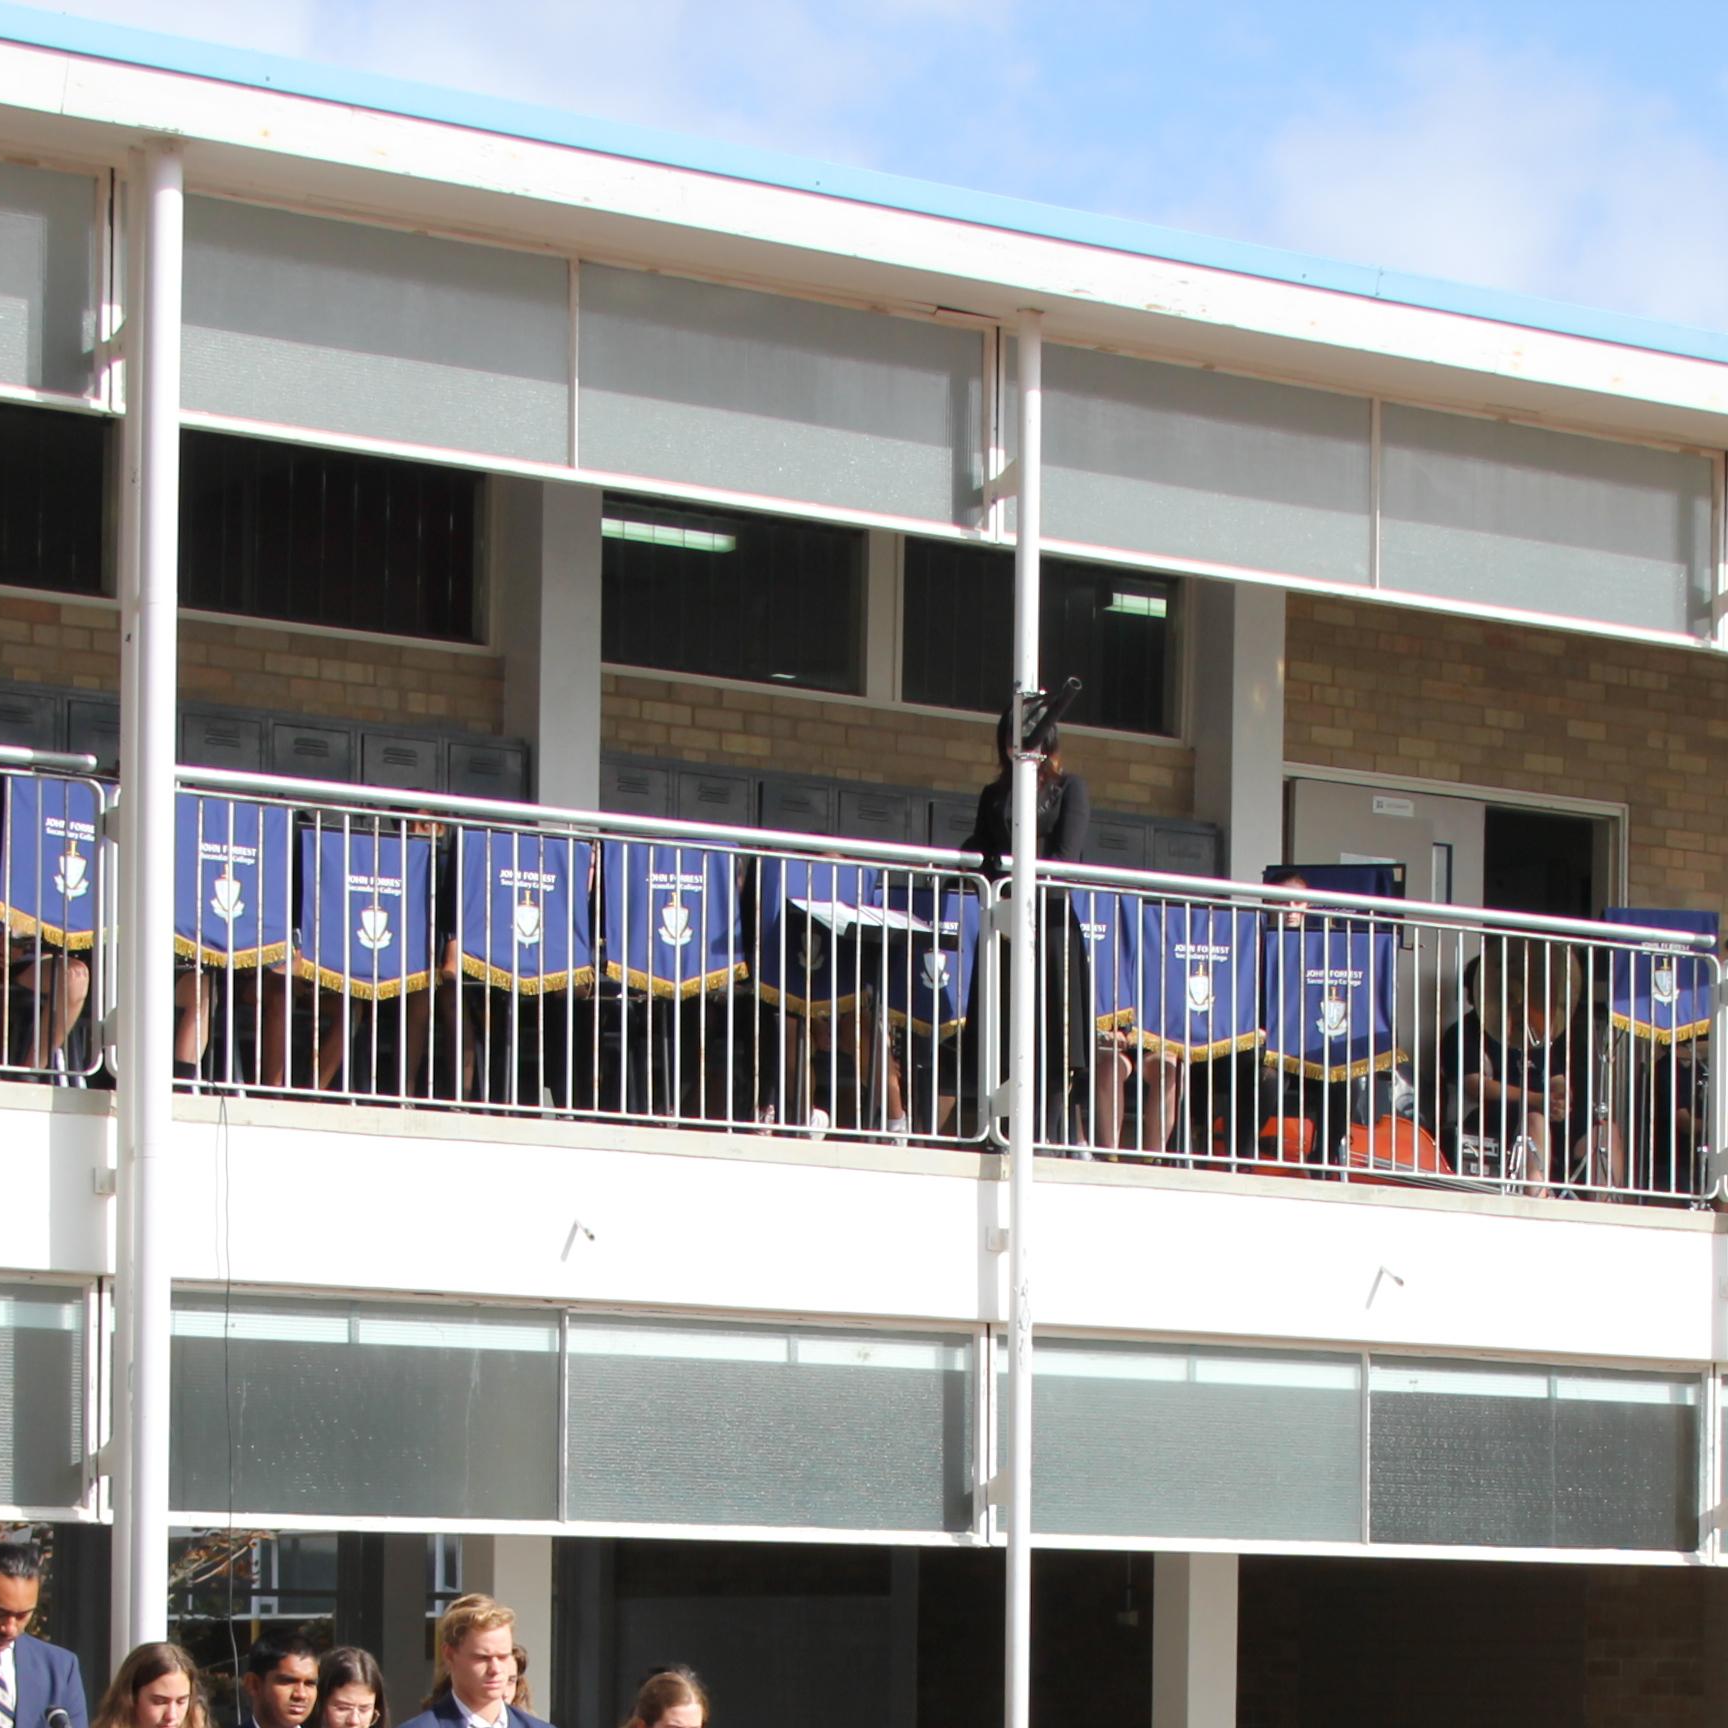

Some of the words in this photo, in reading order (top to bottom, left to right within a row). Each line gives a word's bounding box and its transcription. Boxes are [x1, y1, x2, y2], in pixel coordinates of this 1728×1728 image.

[199, 842, 221, 853] OHN
[522, 871, 556, 884] FOREST
[645, 873, 668, 884] OHN
[1174, 944, 1196, 954] JON
[1196, 945, 1230, 956] FOREST
